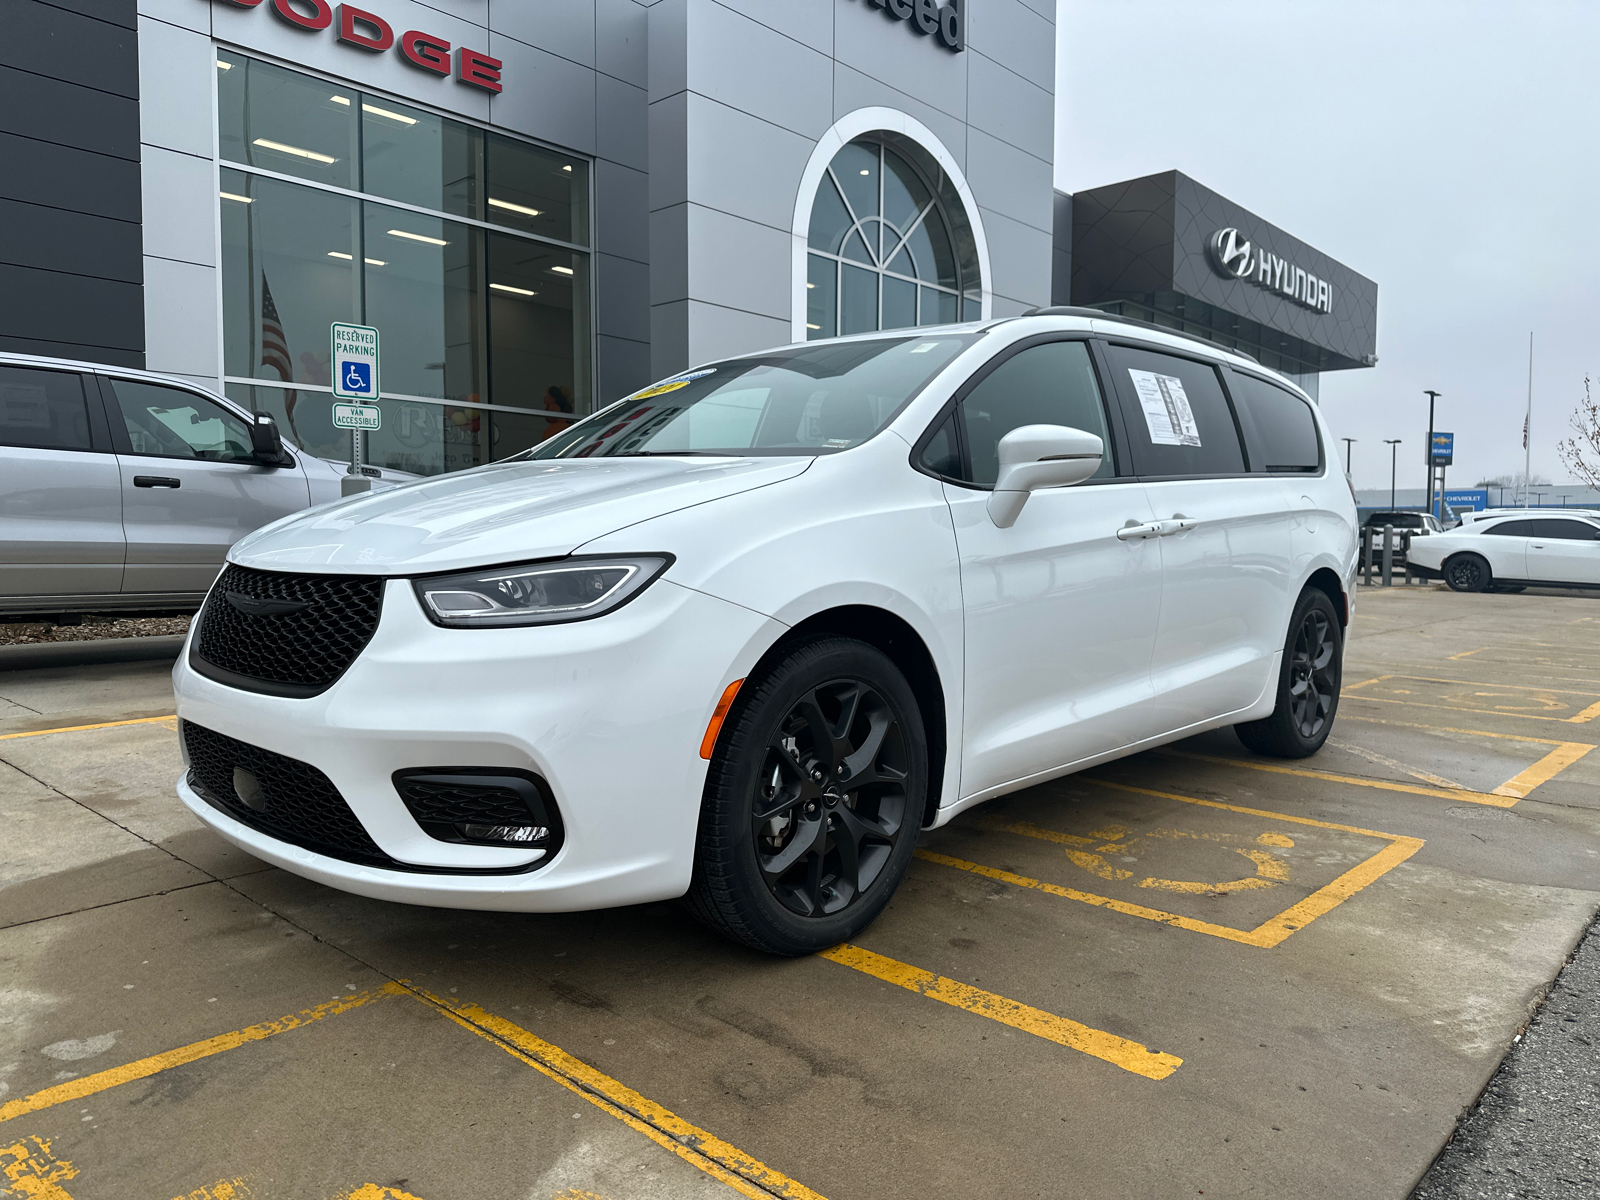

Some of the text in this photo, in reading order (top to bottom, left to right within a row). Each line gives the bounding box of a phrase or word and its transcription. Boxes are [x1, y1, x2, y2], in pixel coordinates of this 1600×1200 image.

[222, 0, 503, 94] ODGE
[1257, 247, 1333, 314] HYUNDAI
[336, 330, 374, 344] RESERVED
[336, 343, 375, 356] PARKING
[350, 408, 364, 416] VAN
[337, 416, 377, 426] ACCESSIBLE
